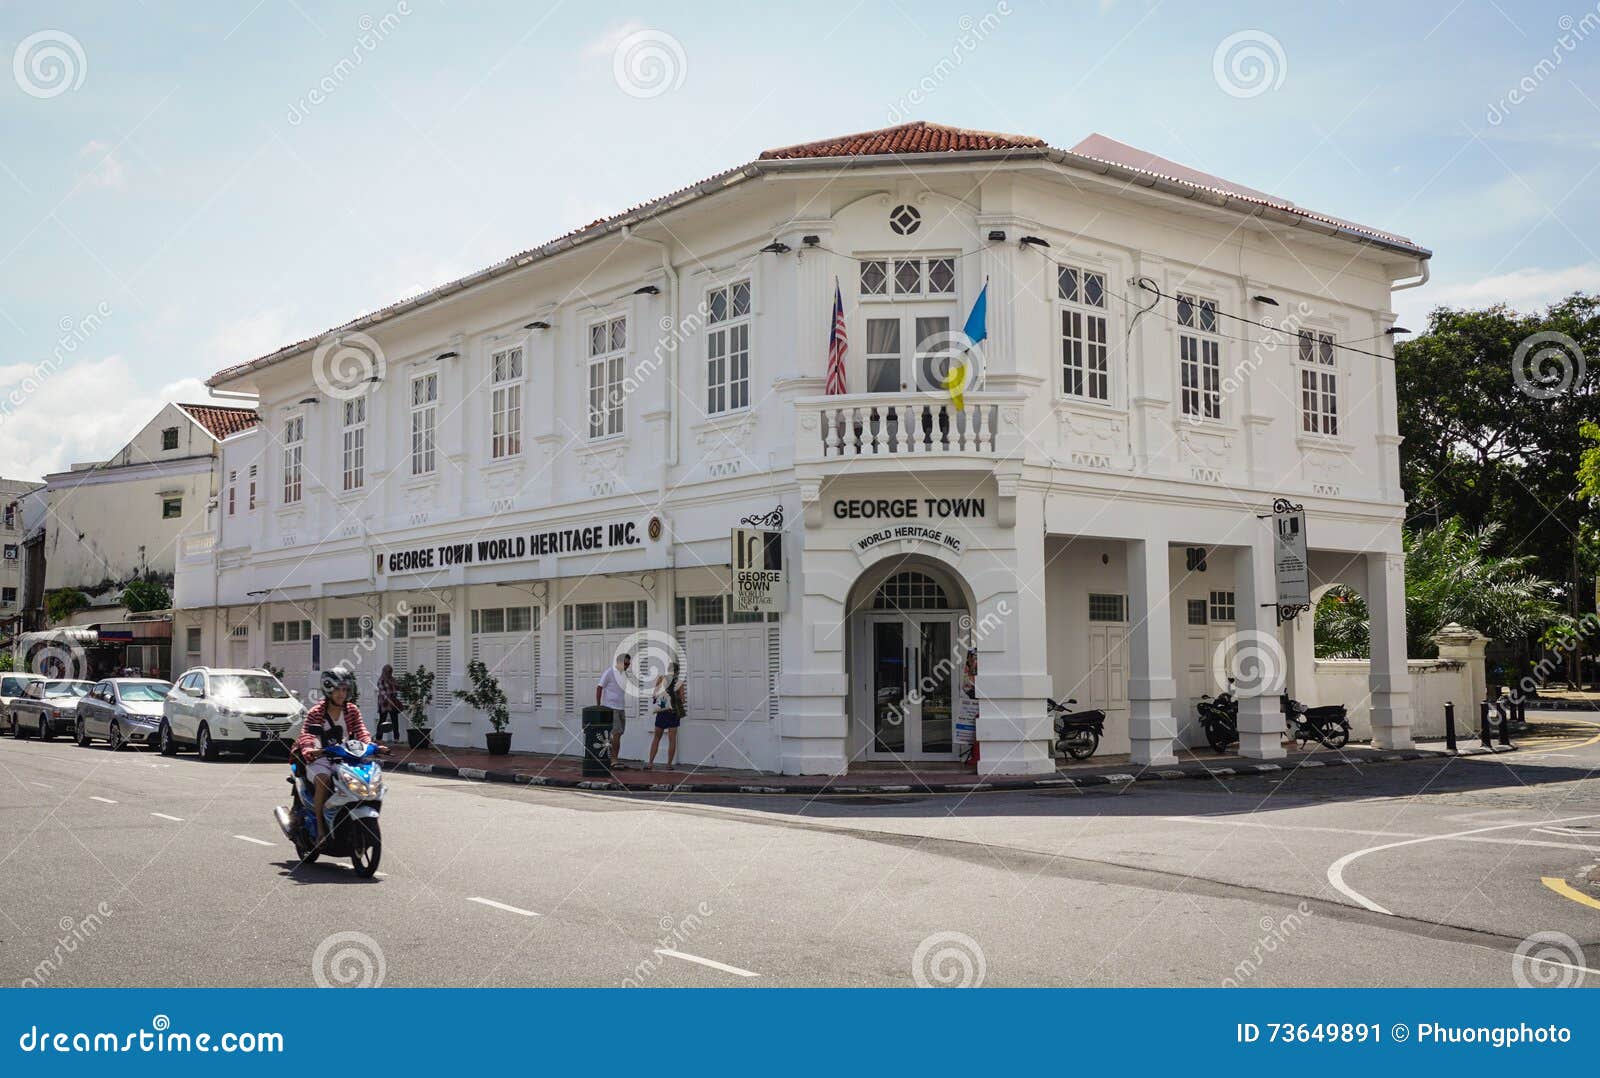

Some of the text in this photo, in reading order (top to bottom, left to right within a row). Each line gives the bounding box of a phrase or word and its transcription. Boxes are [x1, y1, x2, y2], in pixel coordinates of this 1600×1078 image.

[834, 498, 985, 519] GEORGE TOWN
[388, 521, 641, 572] GEORGE TOWN WORLD HERITAGE INC.
[858, 527, 961, 551] WORLD HERITAGE INC.
[738, 571, 780, 582] GEORGE
[738, 581, 770, 592] TOWN
